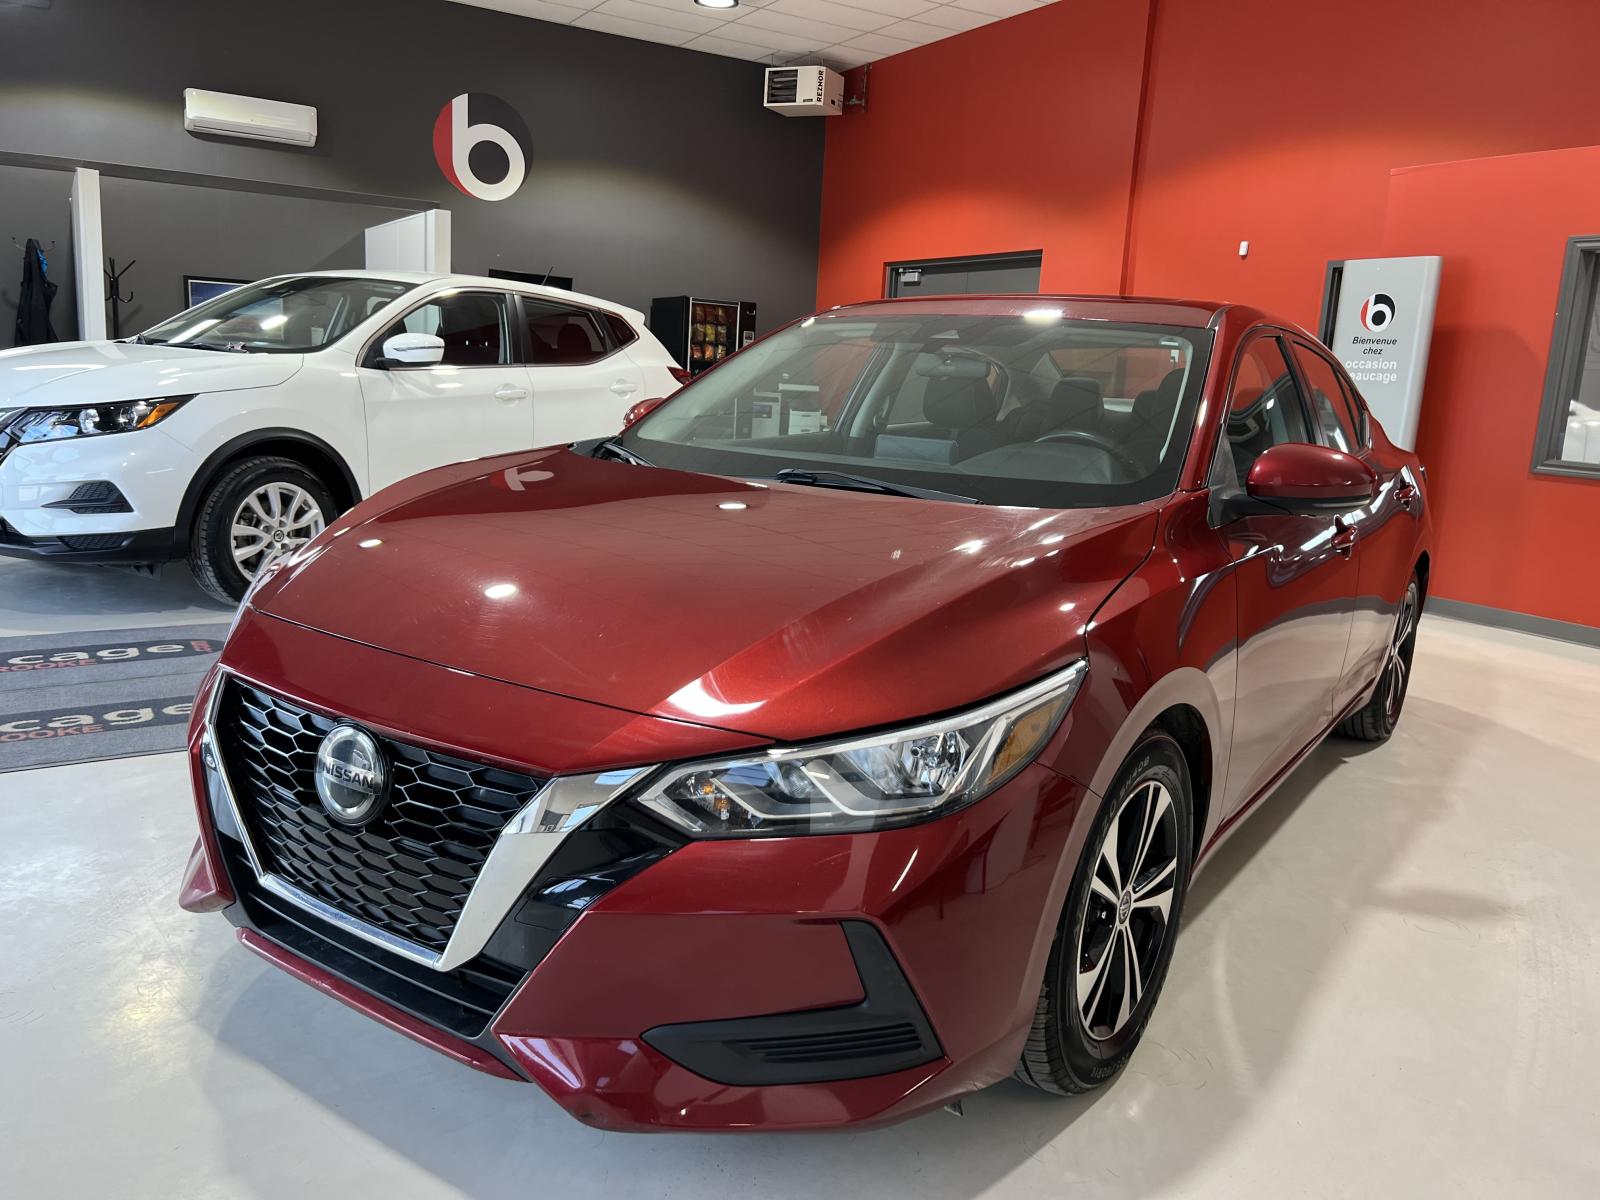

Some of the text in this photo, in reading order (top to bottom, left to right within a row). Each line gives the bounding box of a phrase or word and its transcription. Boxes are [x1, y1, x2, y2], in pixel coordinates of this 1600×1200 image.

[817, 70, 825, 102] REZNOR
[1352, 336, 1398, 346] Bienvenue
[1362, 347, 1383, 355] chez
[1345, 359, 1397, 370] occasion
[322, 761, 374, 789] NISSAN
